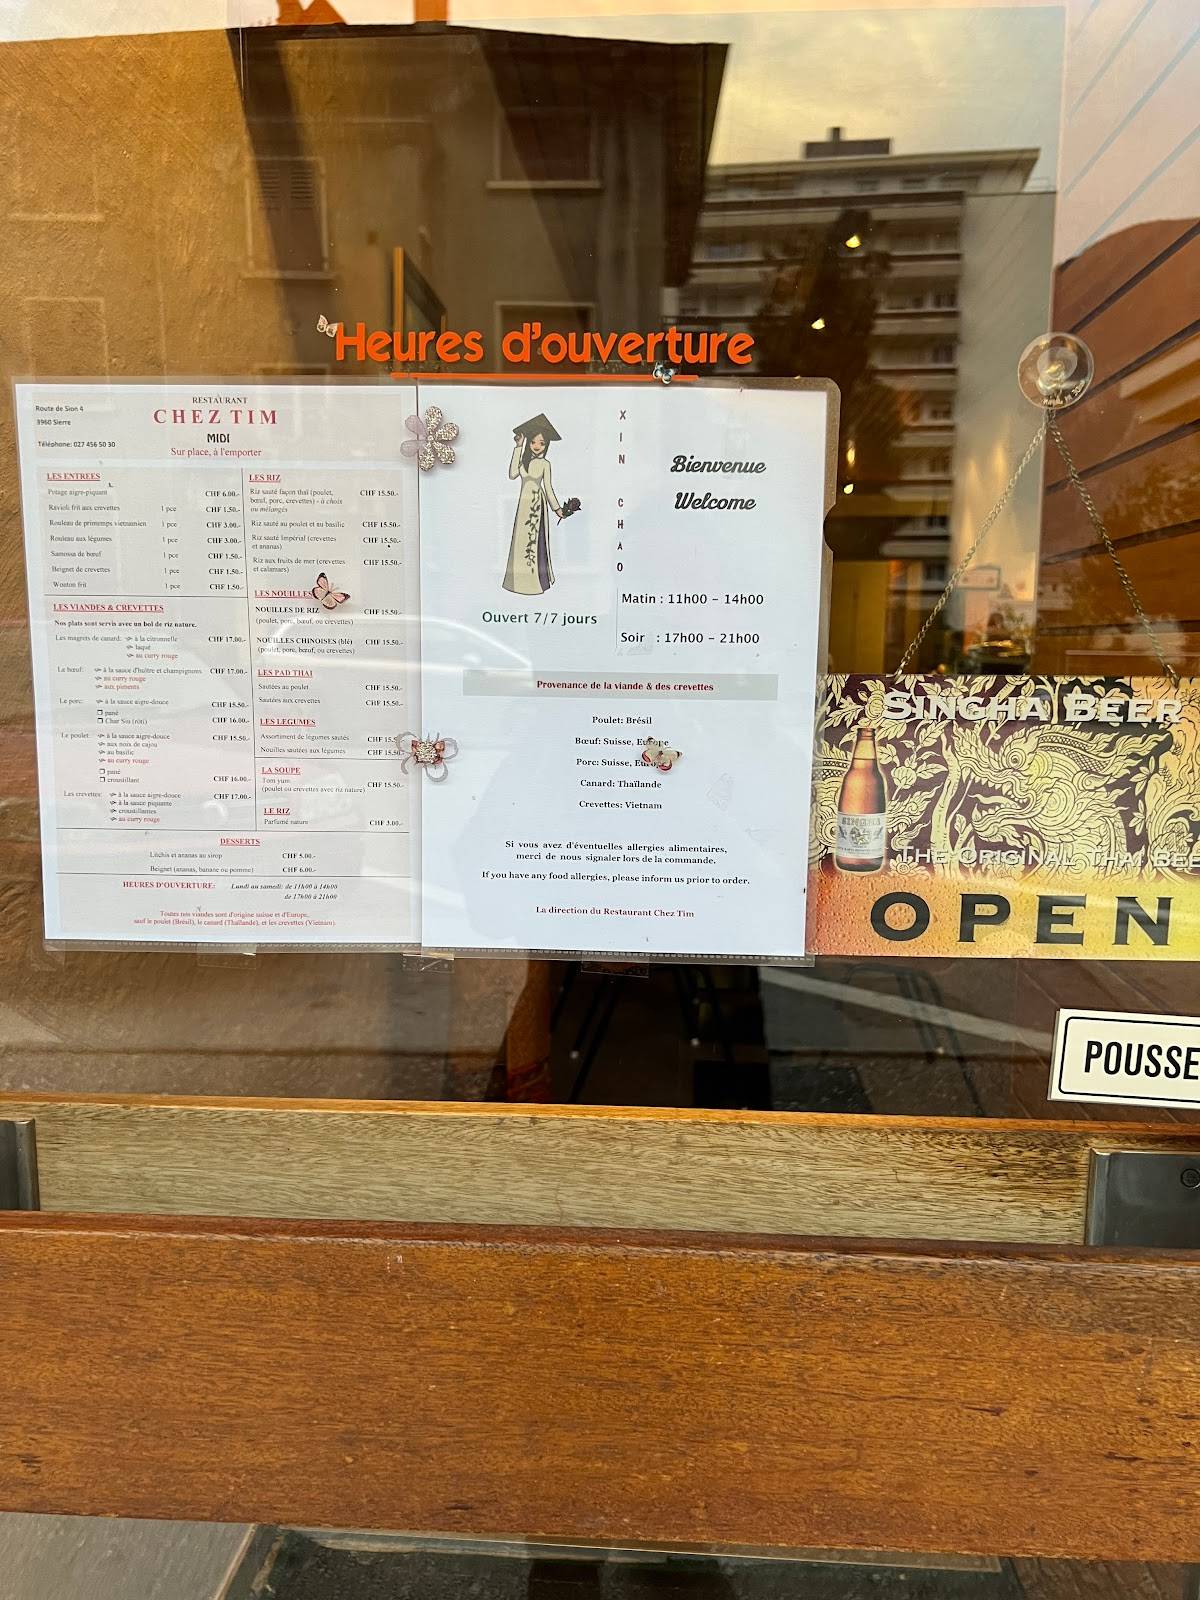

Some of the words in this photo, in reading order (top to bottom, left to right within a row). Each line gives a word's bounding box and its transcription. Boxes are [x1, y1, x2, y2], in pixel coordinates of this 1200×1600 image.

[335, 322, 484, 363] Heures
[502, 322, 755, 366] d'ouverture
[192, 396, 248, 405] RESTAURANT
[154, 409, 220, 424] CHEZ
[230, 410, 277, 424] TIM
[52, 418, 71, 426] Sierre
[207, 434, 230, 443] MIDI
[170, 448, 186, 458] Sur
[186, 447, 212, 458] place,
[212, 448, 219, 456] à
[220, 448, 262, 459] l'emporter
[670, 455, 766, 474] Bienvenue
[64, 472, 101, 480] ENTREES
[267, 474, 281, 482] RIZ
[674, 491, 756, 510] Welcome
[255, 590, 271, 598] LES
[271, 590, 313, 599] NOUILLES
[622, 593, 655, 604] Matin
[668, 593, 707, 606] 11h00
[725, 594, 764, 605] 14h00
[116, 604, 164, 612] CREVETTES
[482, 612, 528, 624] Ouvert
[534, 612, 558, 625] 7/7
[561, 612, 597, 627] jours
[296, 637, 336, 646] CHINOISES
[621, 632, 645, 644] Soir
[665, 632, 703, 645] 17h00
[720, 633, 759, 644] 21h00
[365, 684, 380, 692] CHF
[537, 681, 588, 689] Provenance
[614, 682, 643, 690] viande
[656, 681, 670, 691] des
[674, 681, 714, 691] crevettes
[882, 691, 1051, 722] SINGHA
[1065, 693, 1184, 724] BEER
[592, 715, 623, 724] Poulet:
[626, 716, 652, 724] Brésil
[603, 738, 634, 746] Suisse,
[601, 758, 632, 767] Suisse,
[618, 780, 661, 790] Thaïlande
[579, 800, 622, 809] Crevettes:
[566, 842, 622, 850] d'éventuelles
[628, 843, 664, 853] allergies
[669, 844, 727, 854] alimentaires,
[560, 855, 581, 863] nous
[586, 854, 621, 864] signaler
[654, 854, 662, 863] la
[665, 854, 716, 864] commande.
[900, 846, 947, 866] THE
[956, 848, 1077, 868] ORIGINAL
[1088, 849, 1144, 868] THAI
[571, 872, 610, 883] allergies,
[612, 874, 639, 883] please
[642, 875, 672, 883] inform
[686, 874, 710, 885] prior
[722, 874, 750, 886] order.
[548, 906, 588, 916] direction
[604, 907, 652, 918] Restaurant
[870, 891, 1174, 946] OPEN
